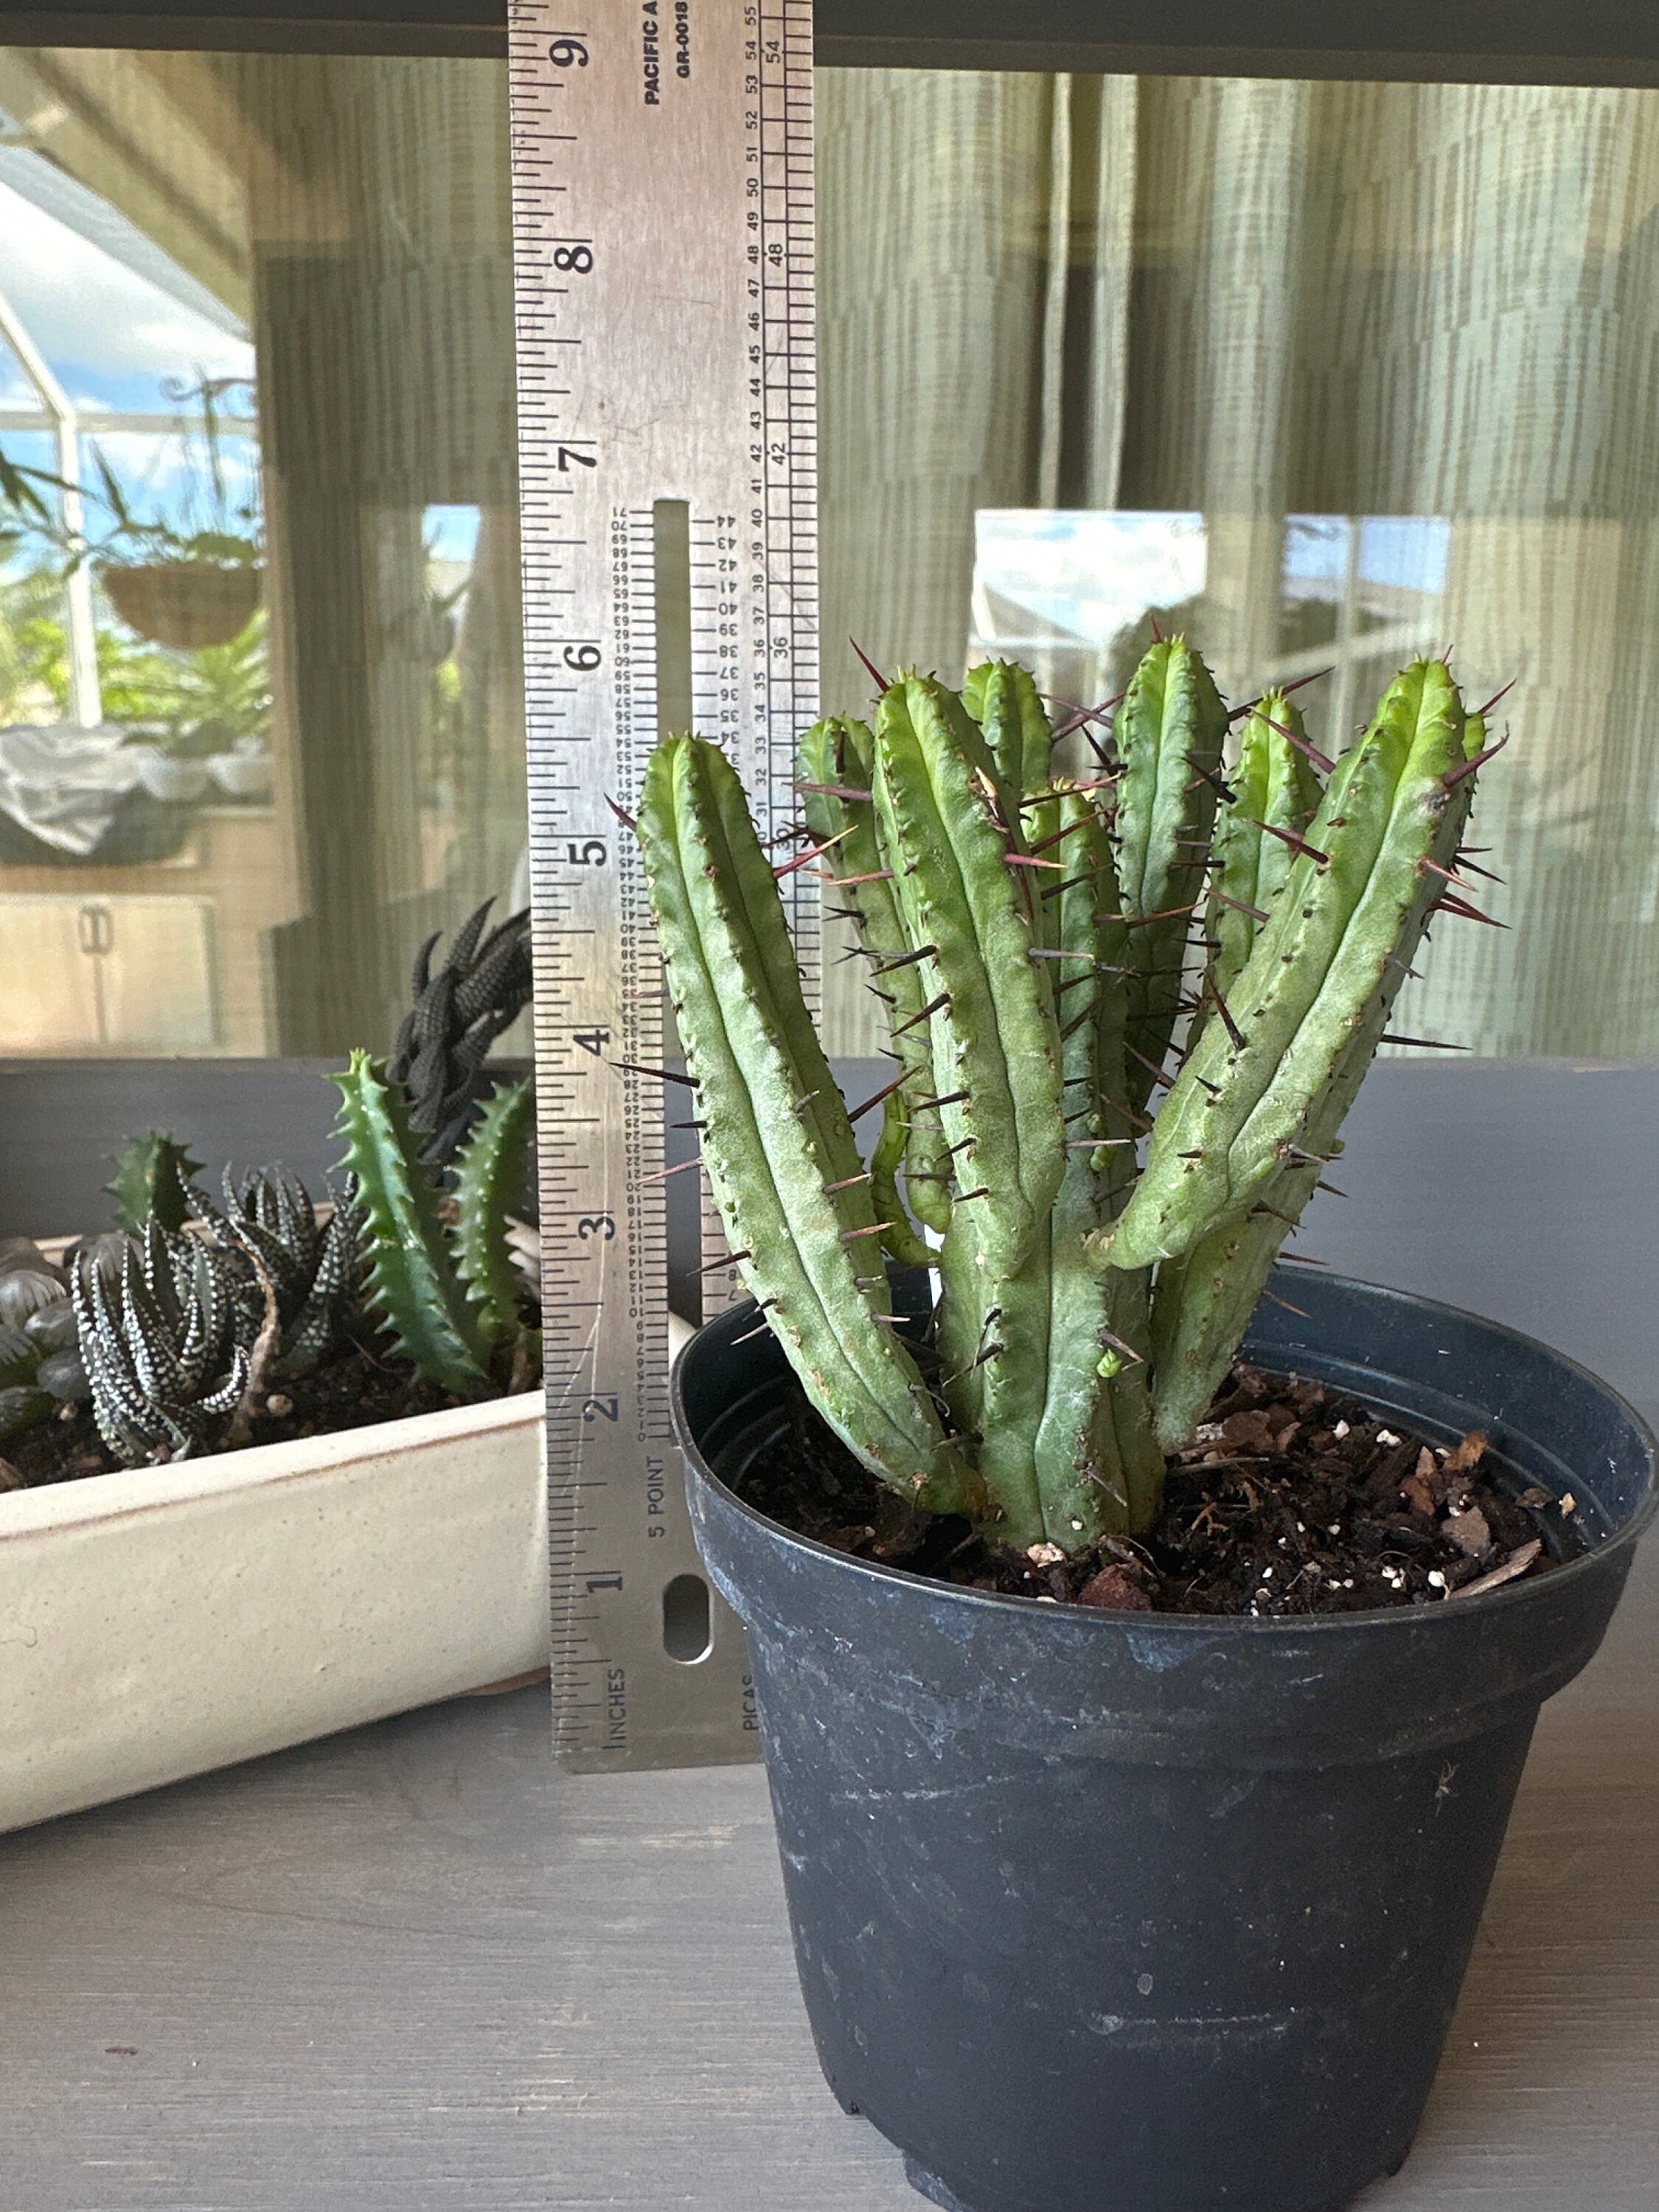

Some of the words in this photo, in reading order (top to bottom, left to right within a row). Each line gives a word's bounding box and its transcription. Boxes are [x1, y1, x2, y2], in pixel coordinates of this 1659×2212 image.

[745, 7, 757, 26] 55
[549, 39, 589, 67] 9
[745, 41, 757, 60] 54
[766, 41, 780, 63] 54
[642, 21, 660, 105] PACIFIC
[745, 75, 758, 94] 53
[745, 111, 757, 129] 52
[746, 147, 758, 162] 51
[747, 178, 759, 197] 50
[748, 212, 759, 231] 49
[553, 246, 594, 274] 8
[748, 246, 759, 265] 48
[768, 243, 783, 267] 48
[748, 279, 759, 298] 47
[748, 313, 759, 331] 46
[749, 345, 760, 364] 45
[750, 379, 761, 397] 44
[750, 411, 762, 430] 43
[558, 447, 597, 472] 7
[750, 445, 762, 462] 42
[771, 442, 786, 465] 42
[751, 479, 762, 494] 41
[717, 515, 736, 528] 44
[751, 509, 762, 528] 40
[717, 538, 737, 550] 43
[751, 542, 763, 560] 39
[718, 559, 737, 571] 42
[720, 581, 737, 594] 41
[752, 574, 764, 593] 38
[718, 602, 738, 616] 40
[753, 607, 765, 625] 37
[719, 624, 738, 636] 39
[720, 645, 738, 658] 38
[754, 639, 765, 658] 36
[773, 636, 788, 658] 36
[563, 644, 602, 672] 6
[720, 667, 739, 679] 37
[754, 672, 766, 690] 35
[720, 689, 739, 701] 36
[720, 710, 739, 723] 35
[754, 704, 766, 723] 34
[755, 737, 766, 755] 33
[756, 768, 766, 786] 32
[757, 801, 767, 817] 31
[567, 841, 607, 867] 5
[573, 1029, 611, 1057] 4
[578, 1217, 616, 1241] 3
[582, 1399, 619, 1422] 2
[647, 1455, 664, 1516] POINT
[648, 1526, 666, 1538] 5
[586, 1576, 623, 1593] 1
[608, 1669, 626, 1740] INCHES
